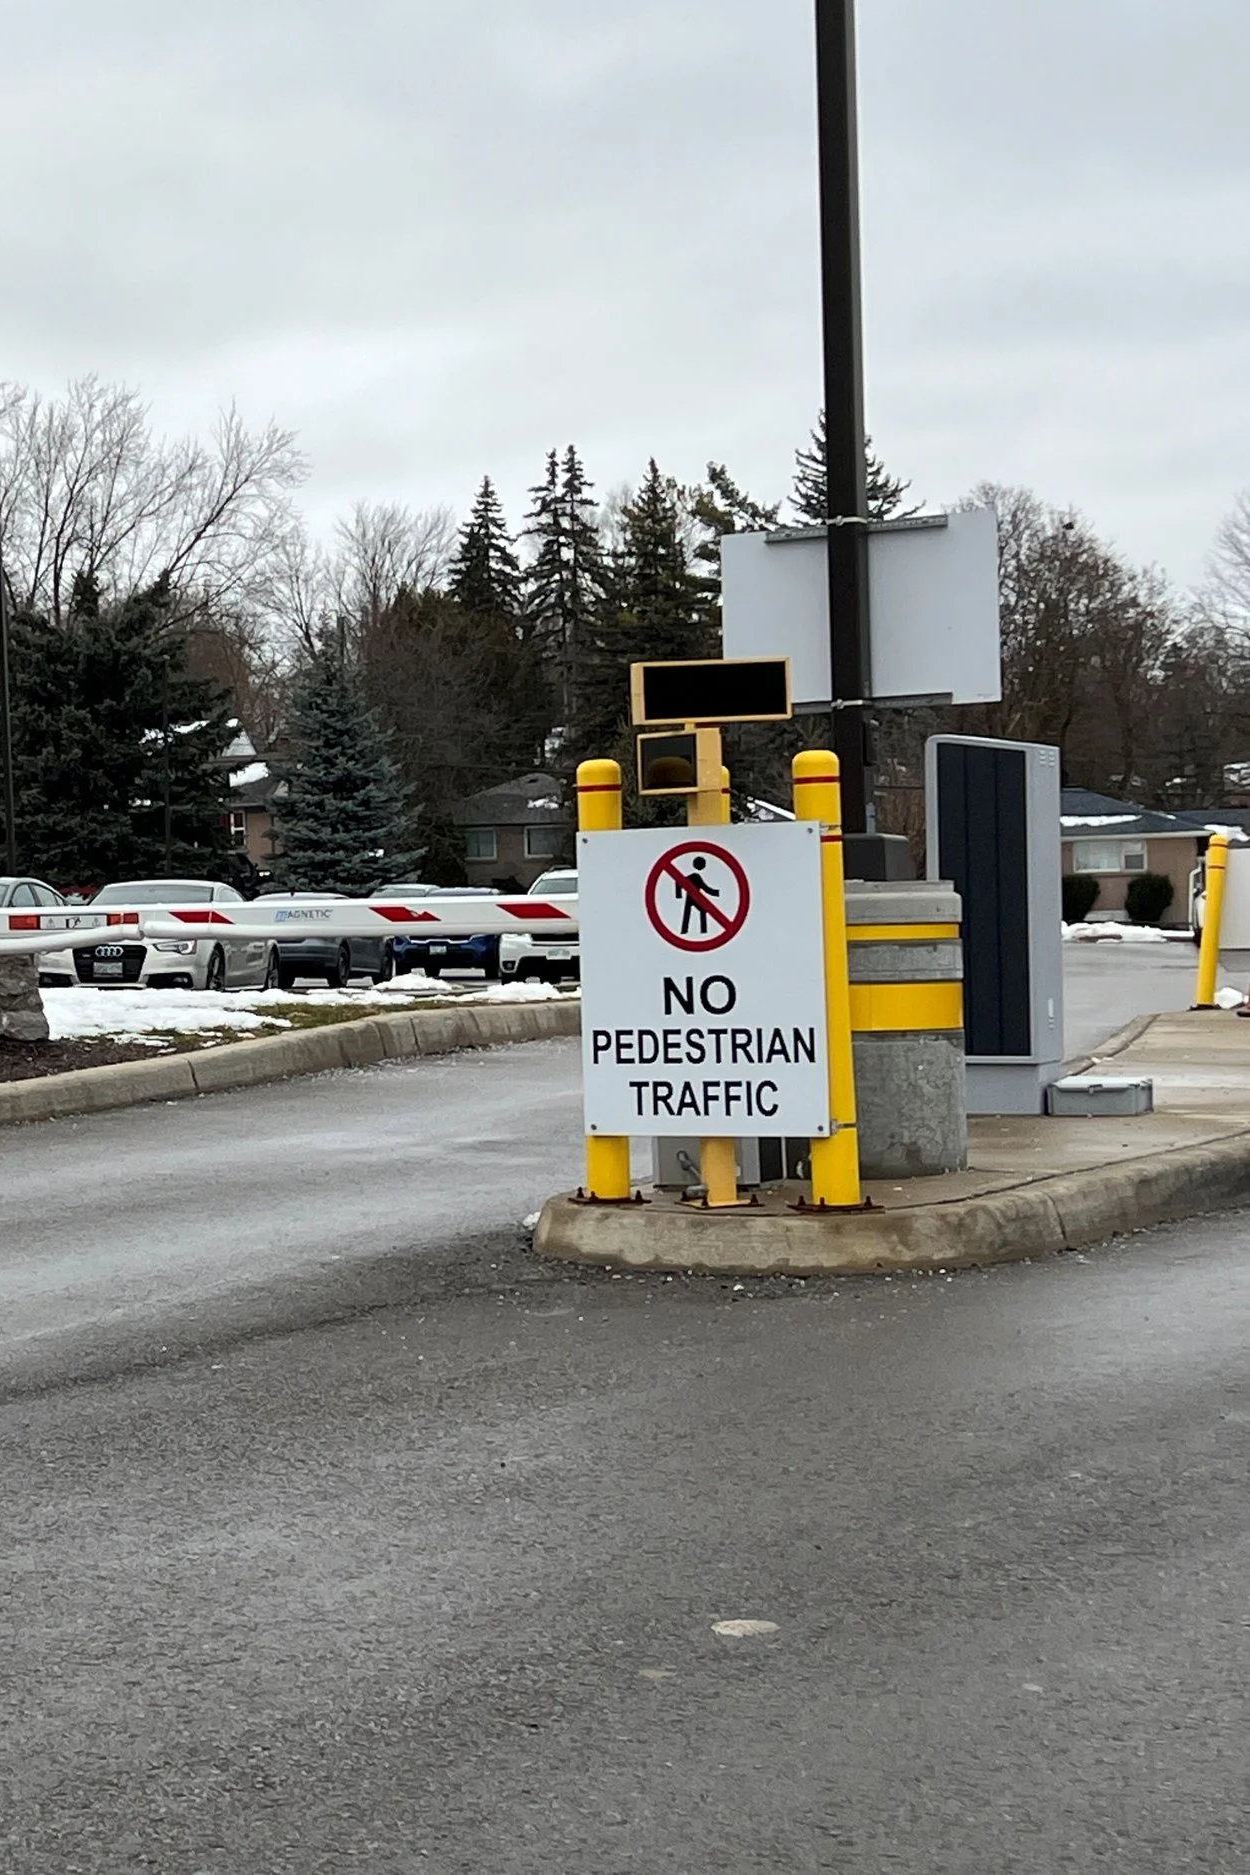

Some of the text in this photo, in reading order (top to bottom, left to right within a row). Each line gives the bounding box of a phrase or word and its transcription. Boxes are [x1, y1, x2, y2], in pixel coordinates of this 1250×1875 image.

[662, 974, 737, 1016] NO
[592, 1027, 816, 1065] PEDESTRIAN
[628, 1080, 779, 1117] TRAFFIC
